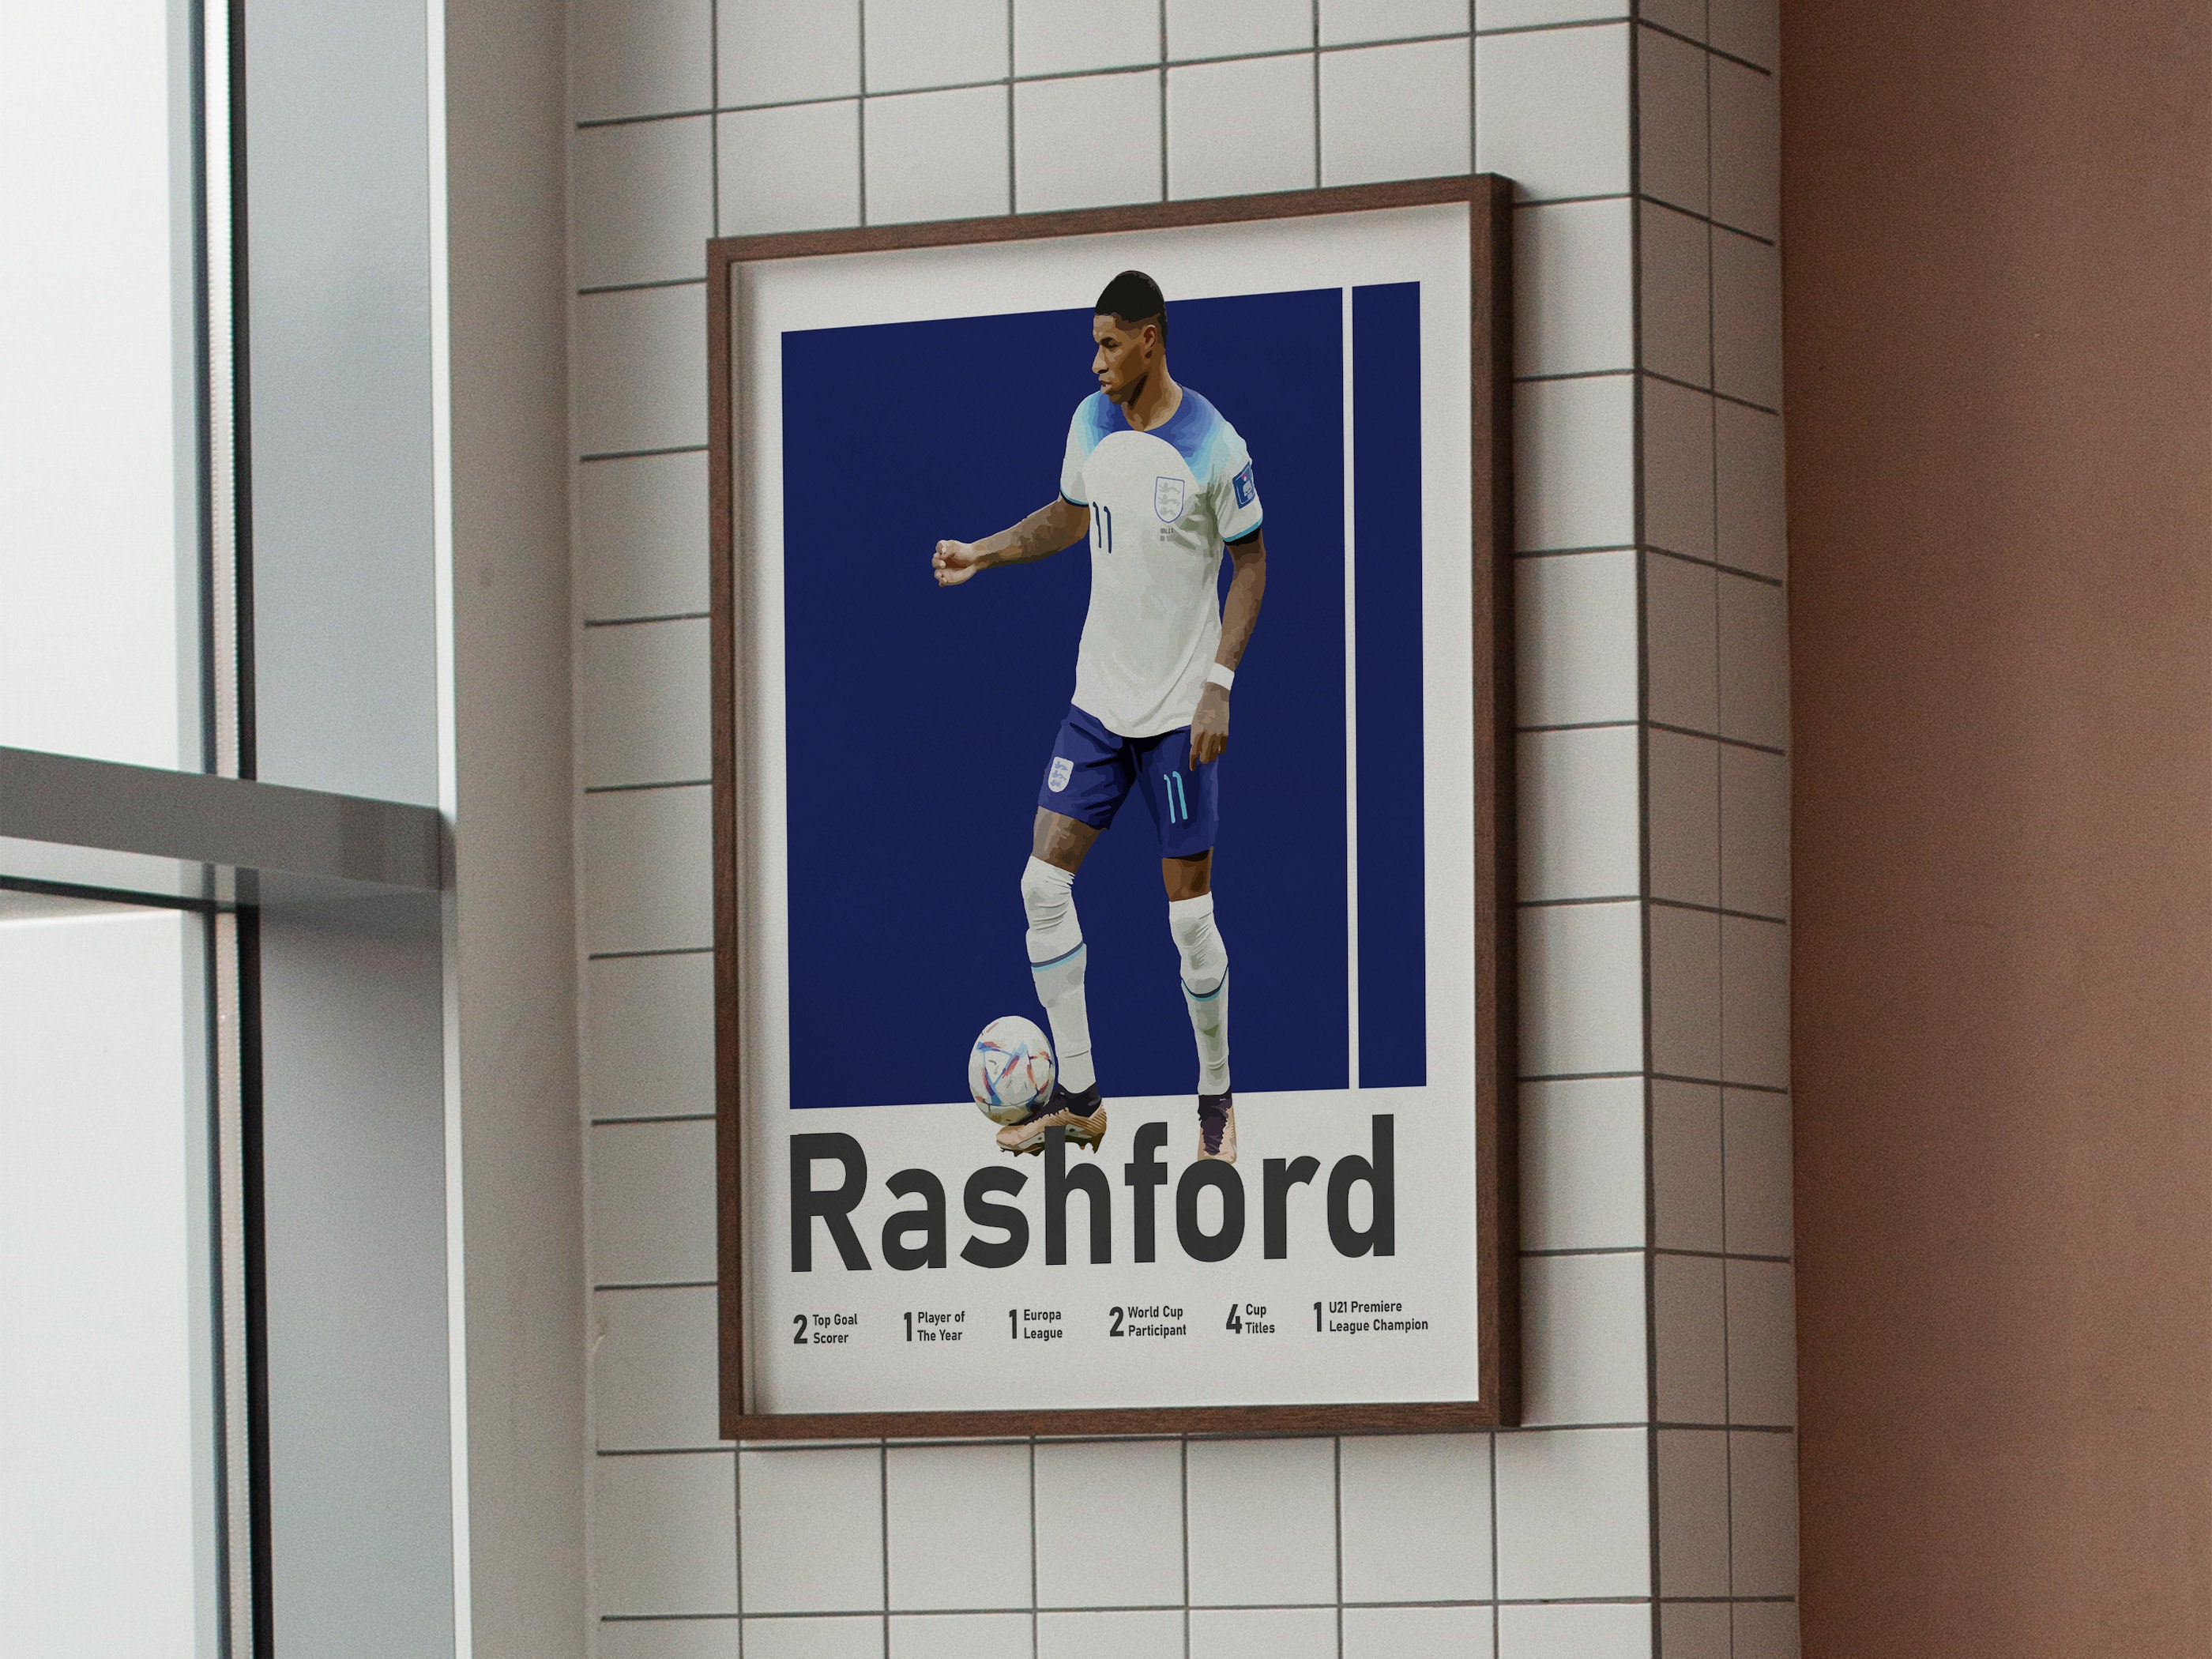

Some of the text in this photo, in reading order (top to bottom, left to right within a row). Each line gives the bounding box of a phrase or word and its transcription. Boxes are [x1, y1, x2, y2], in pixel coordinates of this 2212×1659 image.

[1092, 501, 1112, 555] 11
[1163, 770, 1189, 824] 11
[790, 1114, 1395, 1273] Rashford
[1127, 1305, 1183, 1321] World Cup
[1245, 1303, 1267, 1319] Cup
[1329, 1300, 1402, 1314] U21 Premiere
[812, 1313, 859, 1329] Top Goal
[917, 1310, 965, 1326] Player of
[1008, 1308, 1018, 1340] 1
[1023, 1308, 1062, 1324] Europa
[1108, 1306, 1125, 1337] 2
[1225, 1304, 1243, 1334] 4
[1313, 1301, 1322, 1333] 1
[792, 1314, 808, 1345] 2
[903, 1311, 912, 1342] 1
[1024, 1326, 1063, 1342] League
[1128, 1323, 1187, 1340] Participant
[1245, 1321, 1276, 1334] Titles
[1329, 1318, 1429, 1335] League Champion
[813, 1331, 849, 1345] Scorer
[917, 1329, 963, 1342] The Year
